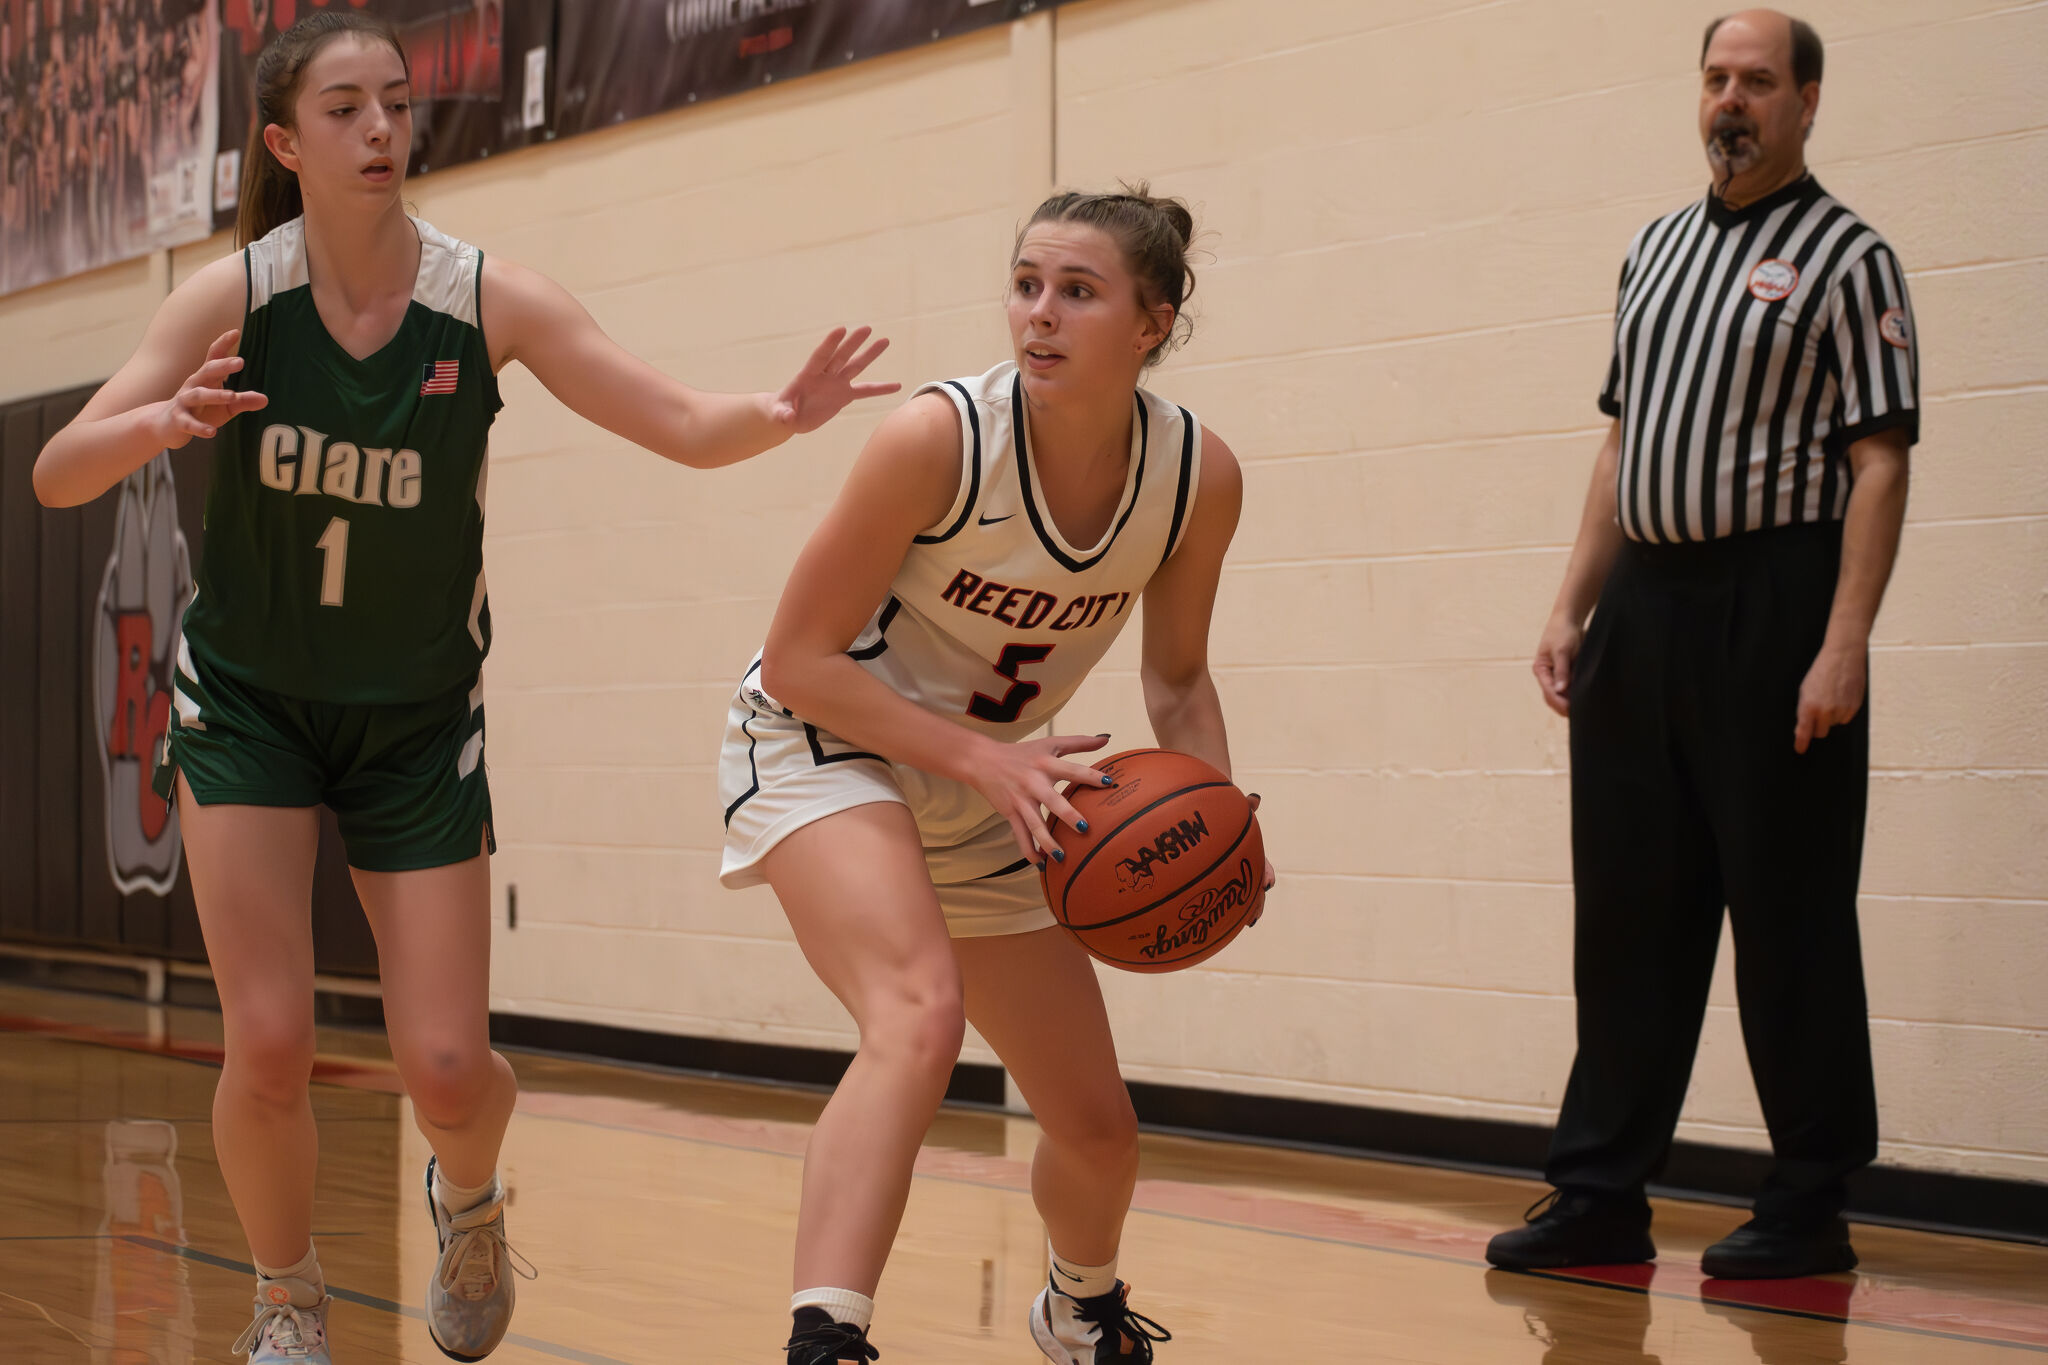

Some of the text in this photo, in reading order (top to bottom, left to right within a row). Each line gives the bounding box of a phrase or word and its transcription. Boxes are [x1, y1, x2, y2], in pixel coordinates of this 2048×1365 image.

[259, 424, 422, 508] Clare
[315, 516, 350, 607] 1
[941, 568, 1058, 629] REED
[966, 643, 1056, 723] 5
[1139, 858, 1253, 958] Rawlings
